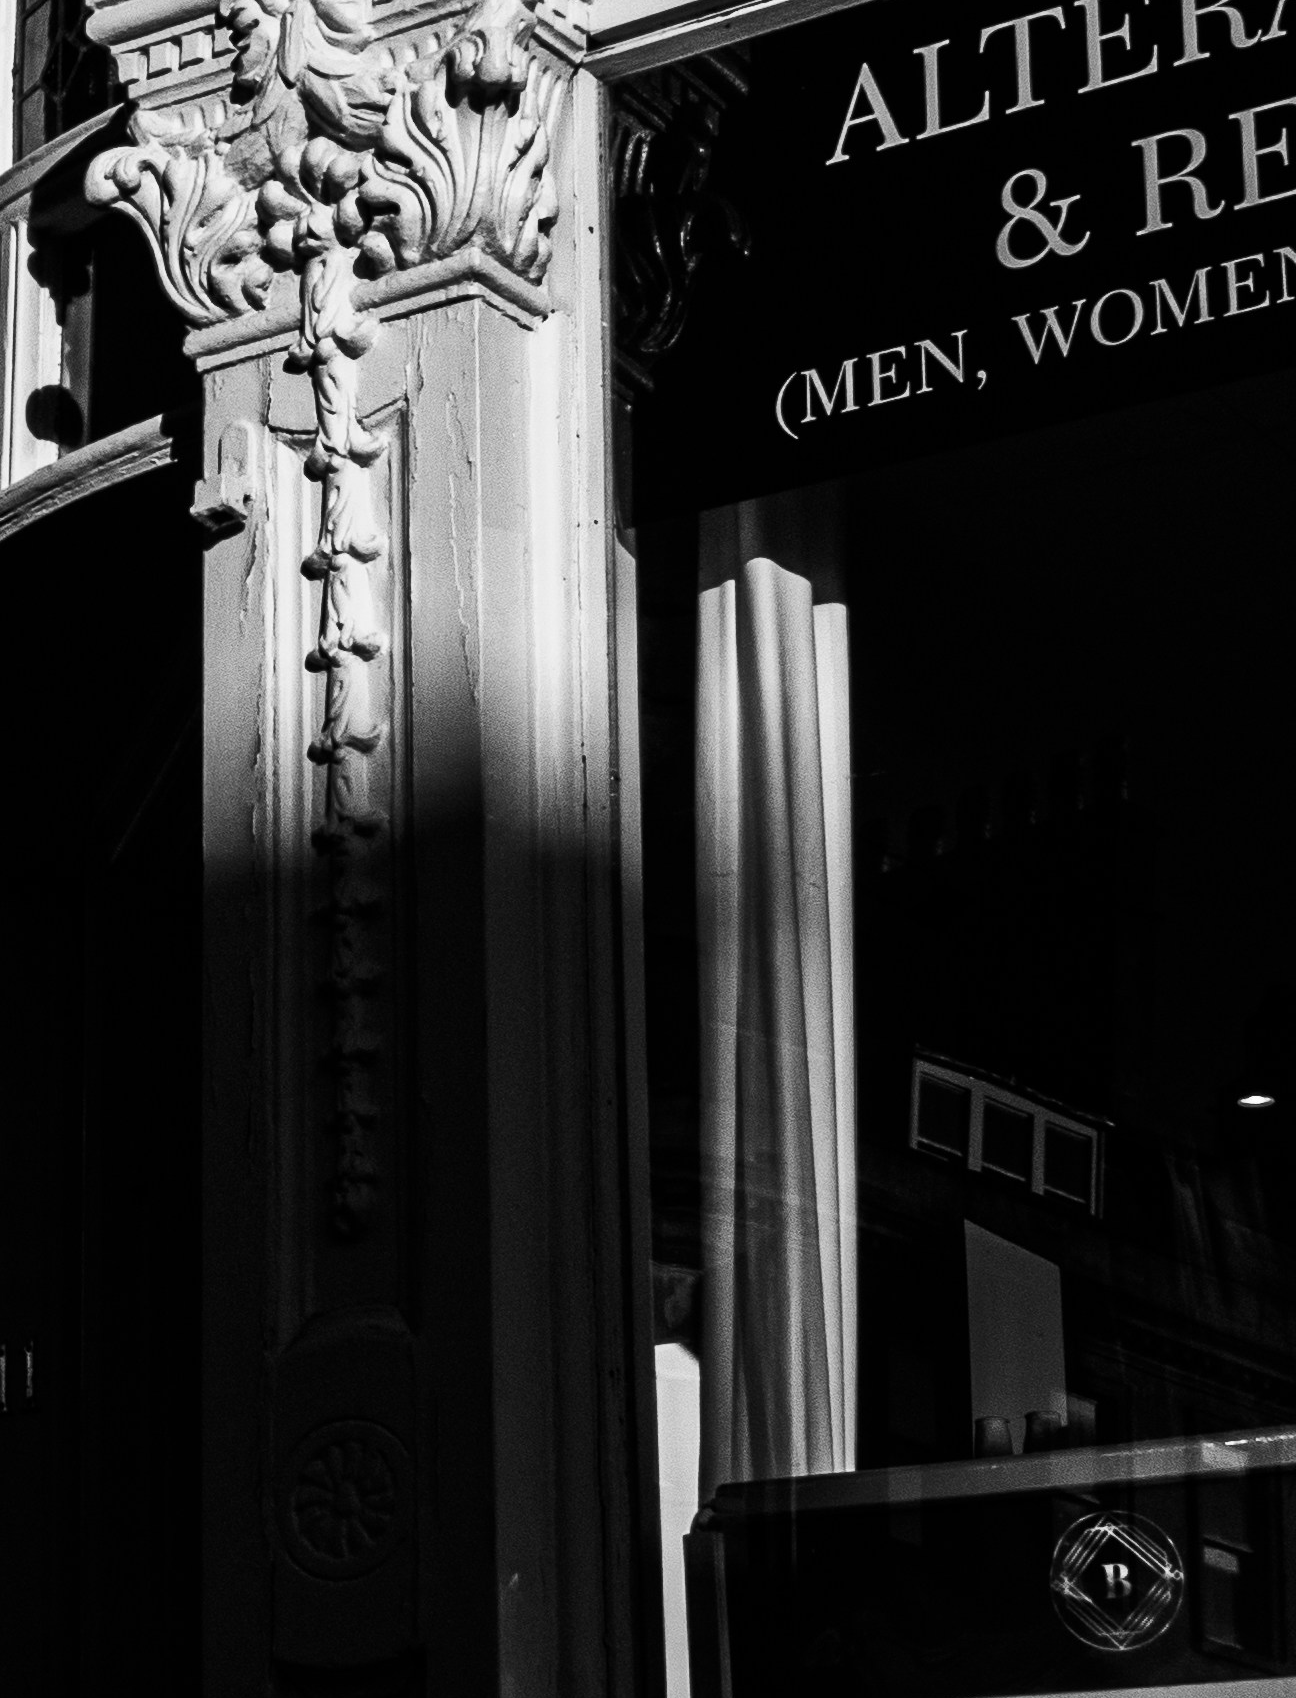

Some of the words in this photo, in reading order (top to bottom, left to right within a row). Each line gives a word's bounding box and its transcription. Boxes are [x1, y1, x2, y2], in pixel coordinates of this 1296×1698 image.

[995, 168, 1090, 269] &
[775, 329, 987, 439] (MEN,
[1101, 1562, 1133, 1599] B
